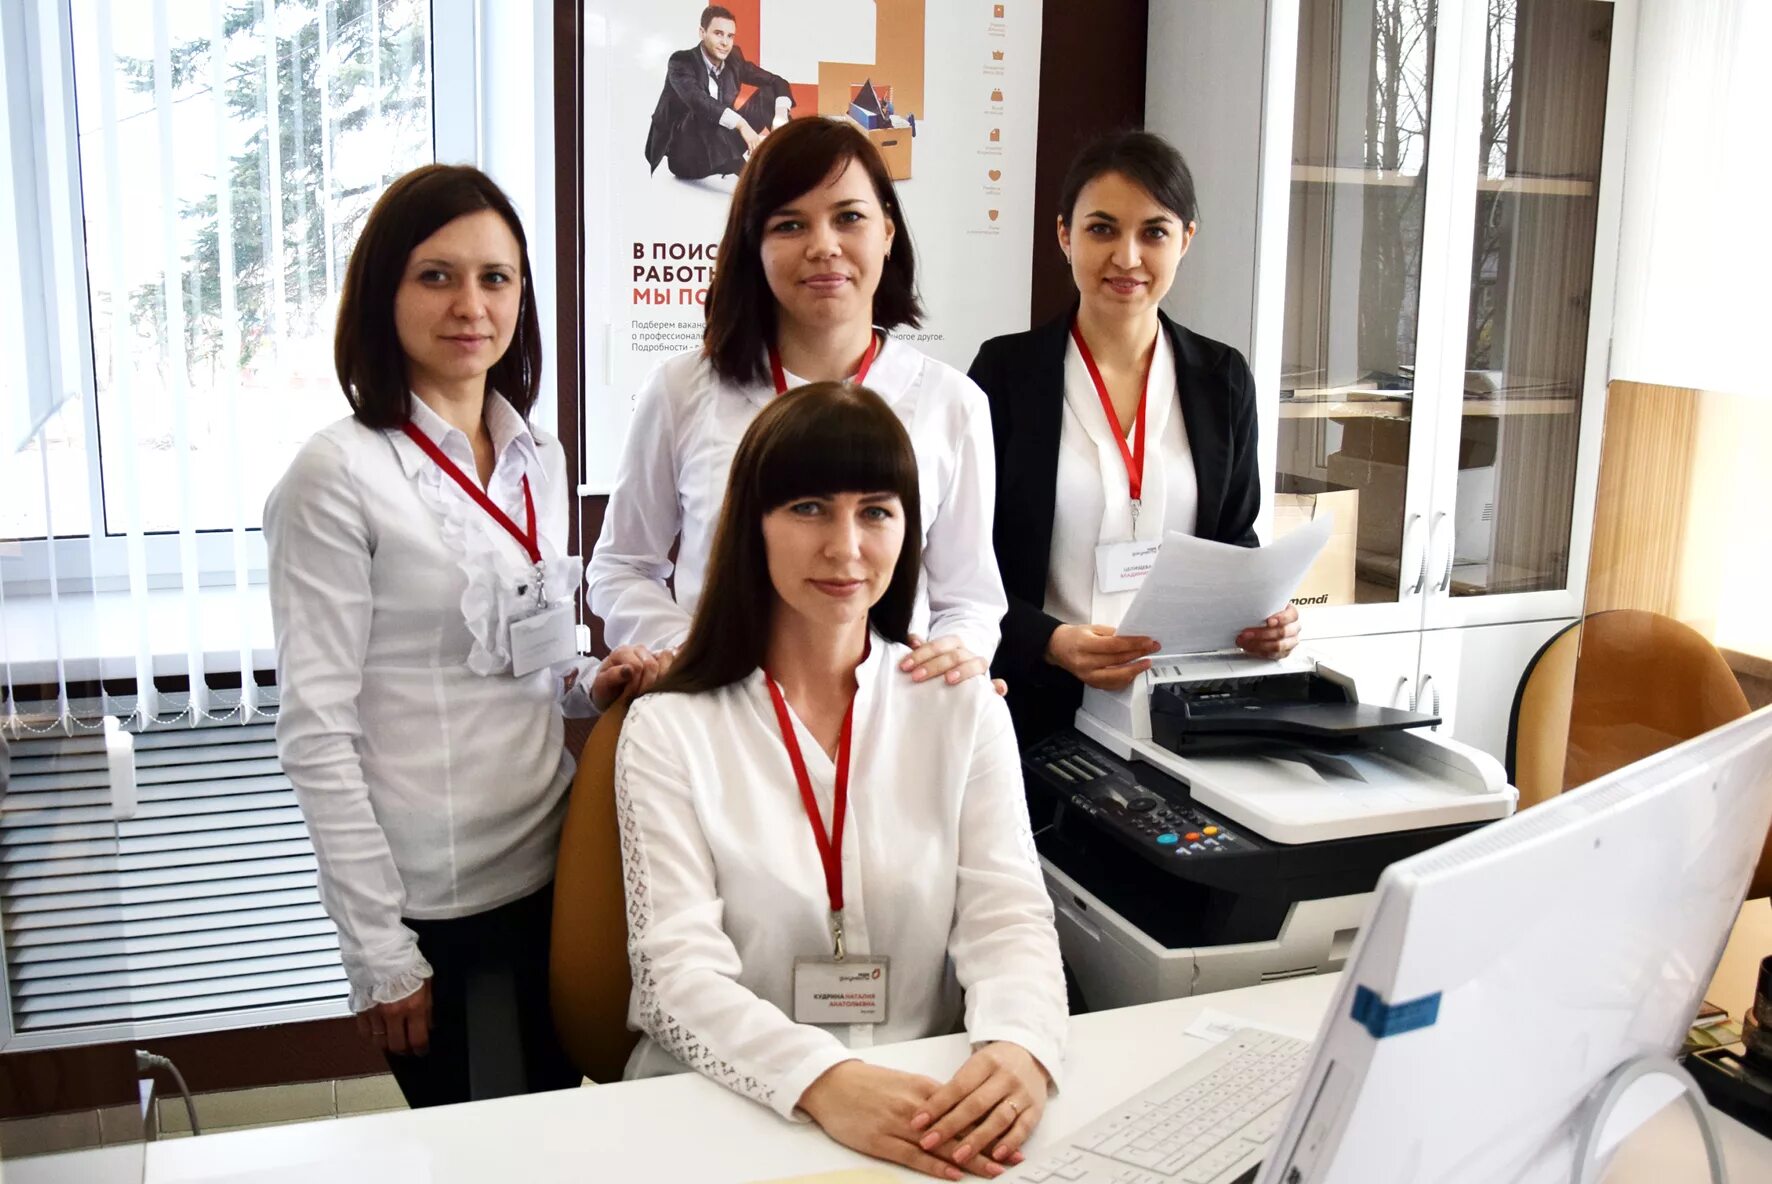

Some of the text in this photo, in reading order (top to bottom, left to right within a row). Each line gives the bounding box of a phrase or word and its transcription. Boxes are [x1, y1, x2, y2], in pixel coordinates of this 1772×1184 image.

[633, 243, 718, 260] В ПОИС
[633, 288, 708, 305] МЫ ПО
[631, 320, 675, 330] Подберем
[631, 331, 705, 342] о профессиональ
[631, 343, 688, 352] Подробности
